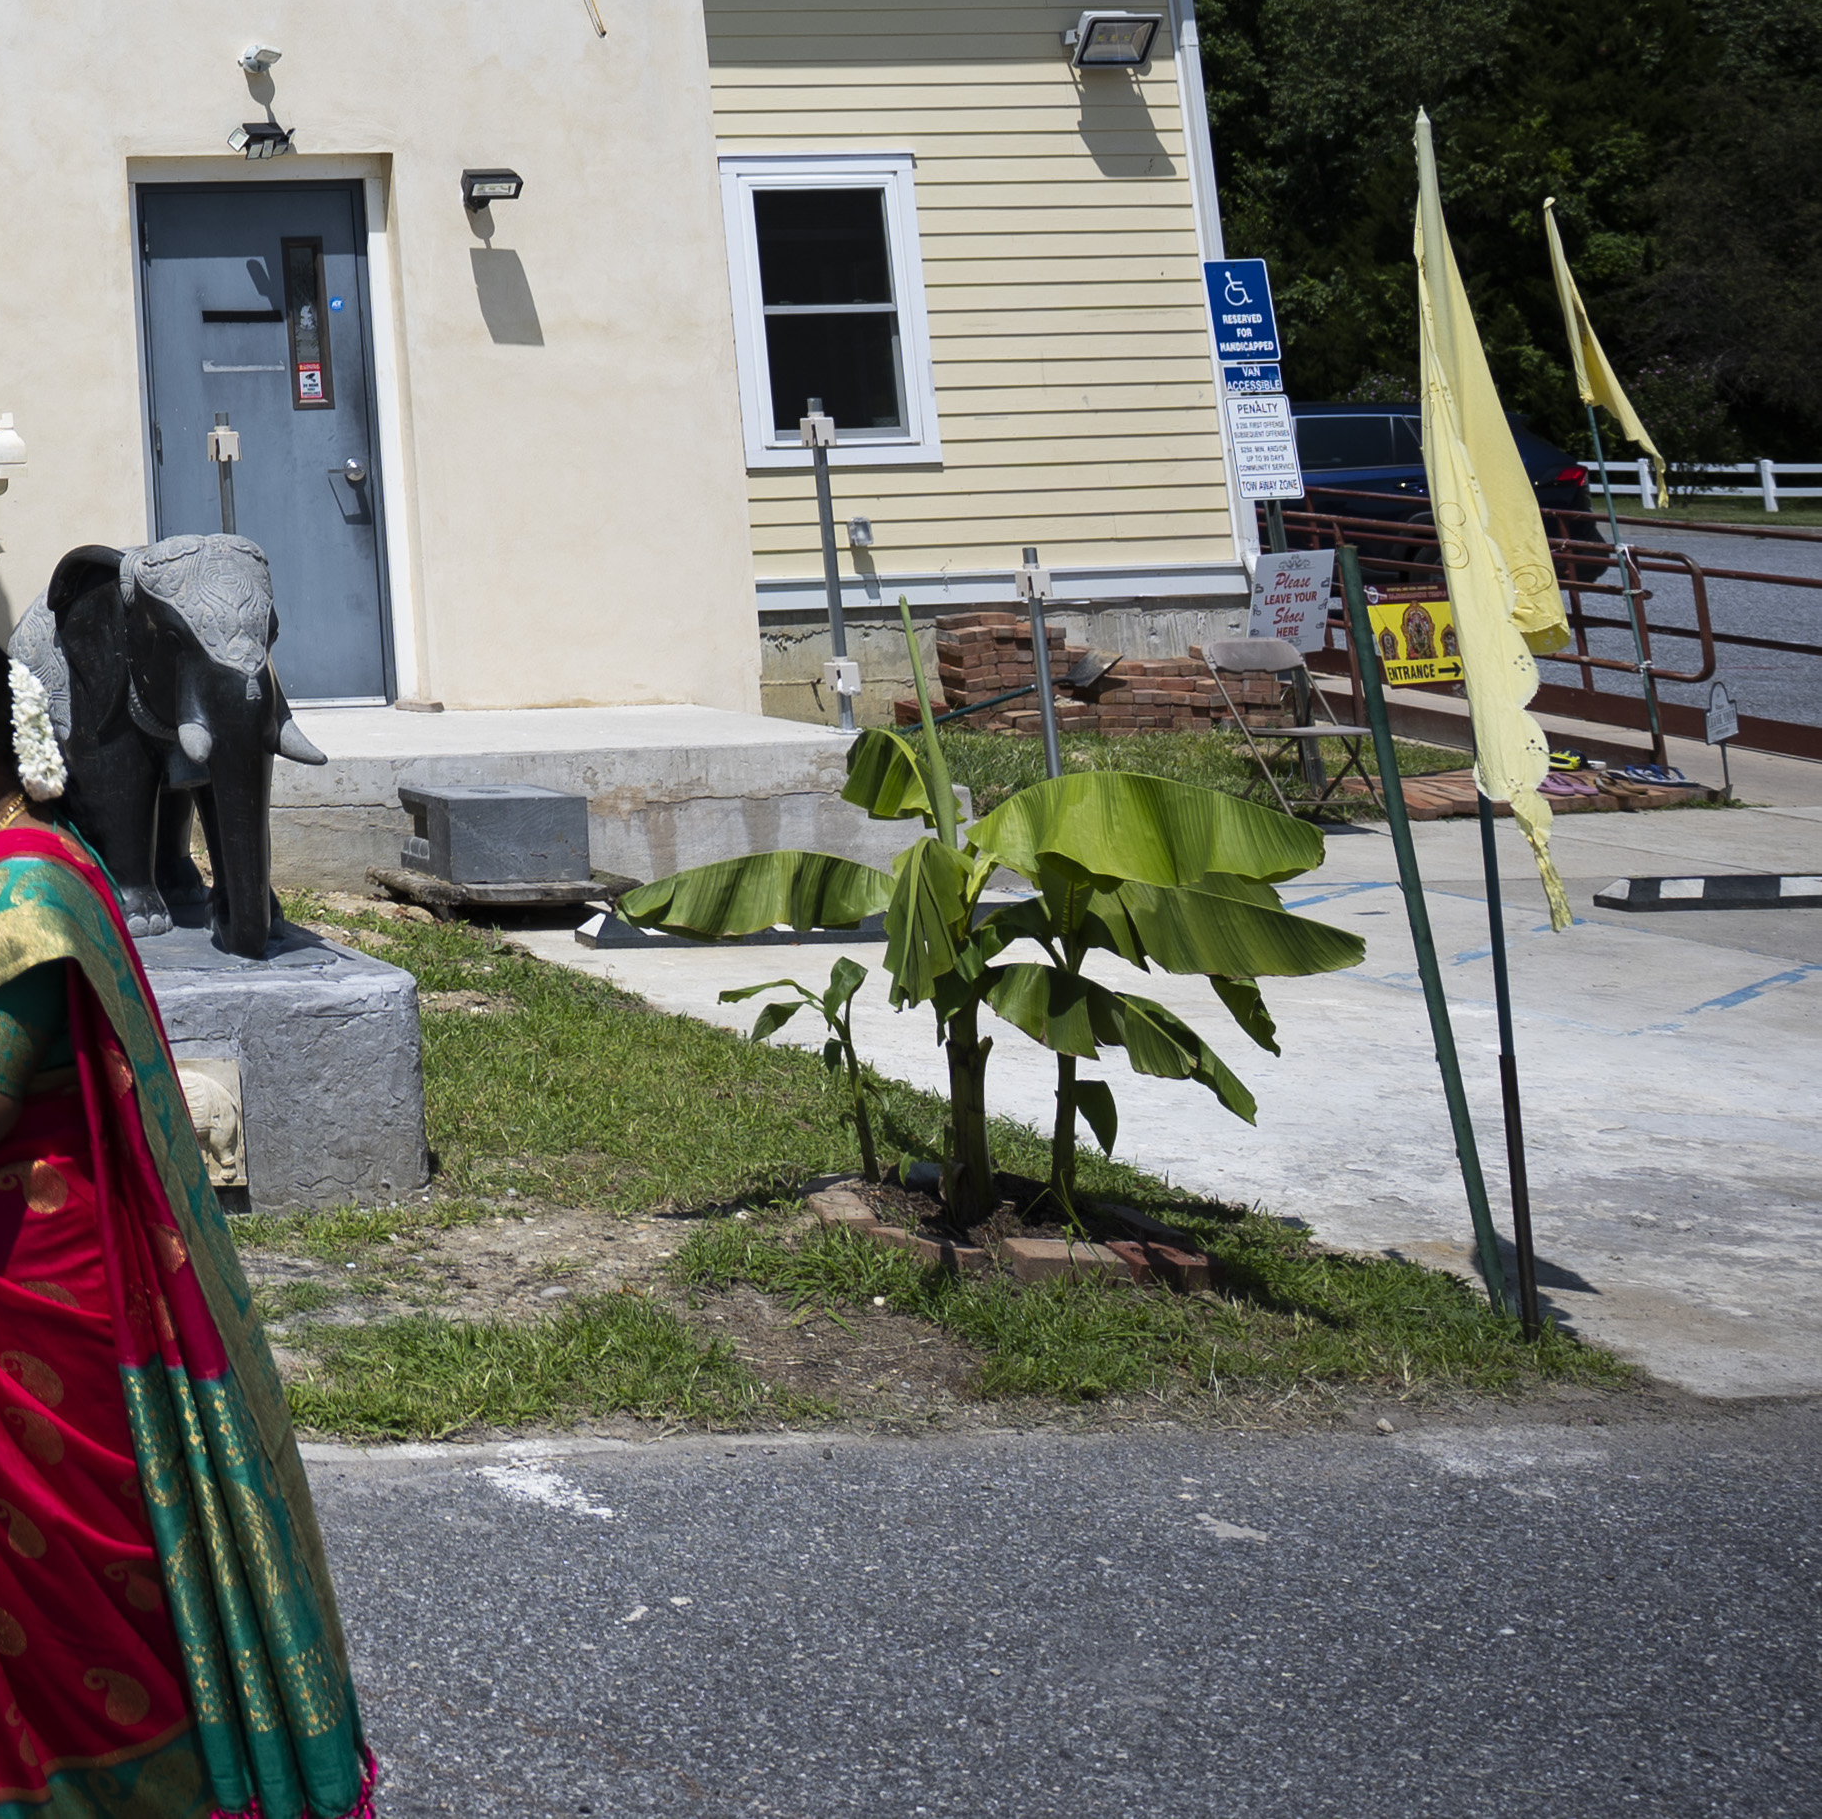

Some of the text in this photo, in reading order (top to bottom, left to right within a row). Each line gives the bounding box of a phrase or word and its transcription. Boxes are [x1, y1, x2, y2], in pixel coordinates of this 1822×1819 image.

[1222, 314, 1262, 325] RESERVED
[1236, 328, 1253, 338] FOR
[1220, 341, 1274, 352] HANDICAPPED
[1242, 366, 1261, 377] VAN
[1227, 380, 1280, 391] ACCESSIBLE
[1237, 403, 1278, 414] PENALTY
[1242, 479, 1298, 491] TOW AWAY ZONE
[1273, 572, 1311, 590] Please
[1264, 591, 1317, 606] LEAVE YOUR
[1273, 606, 1305, 625] Shoes
[1276, 626, 1299, 638] HERE
[1387, 664, 1435, 681] ENTRANCE
